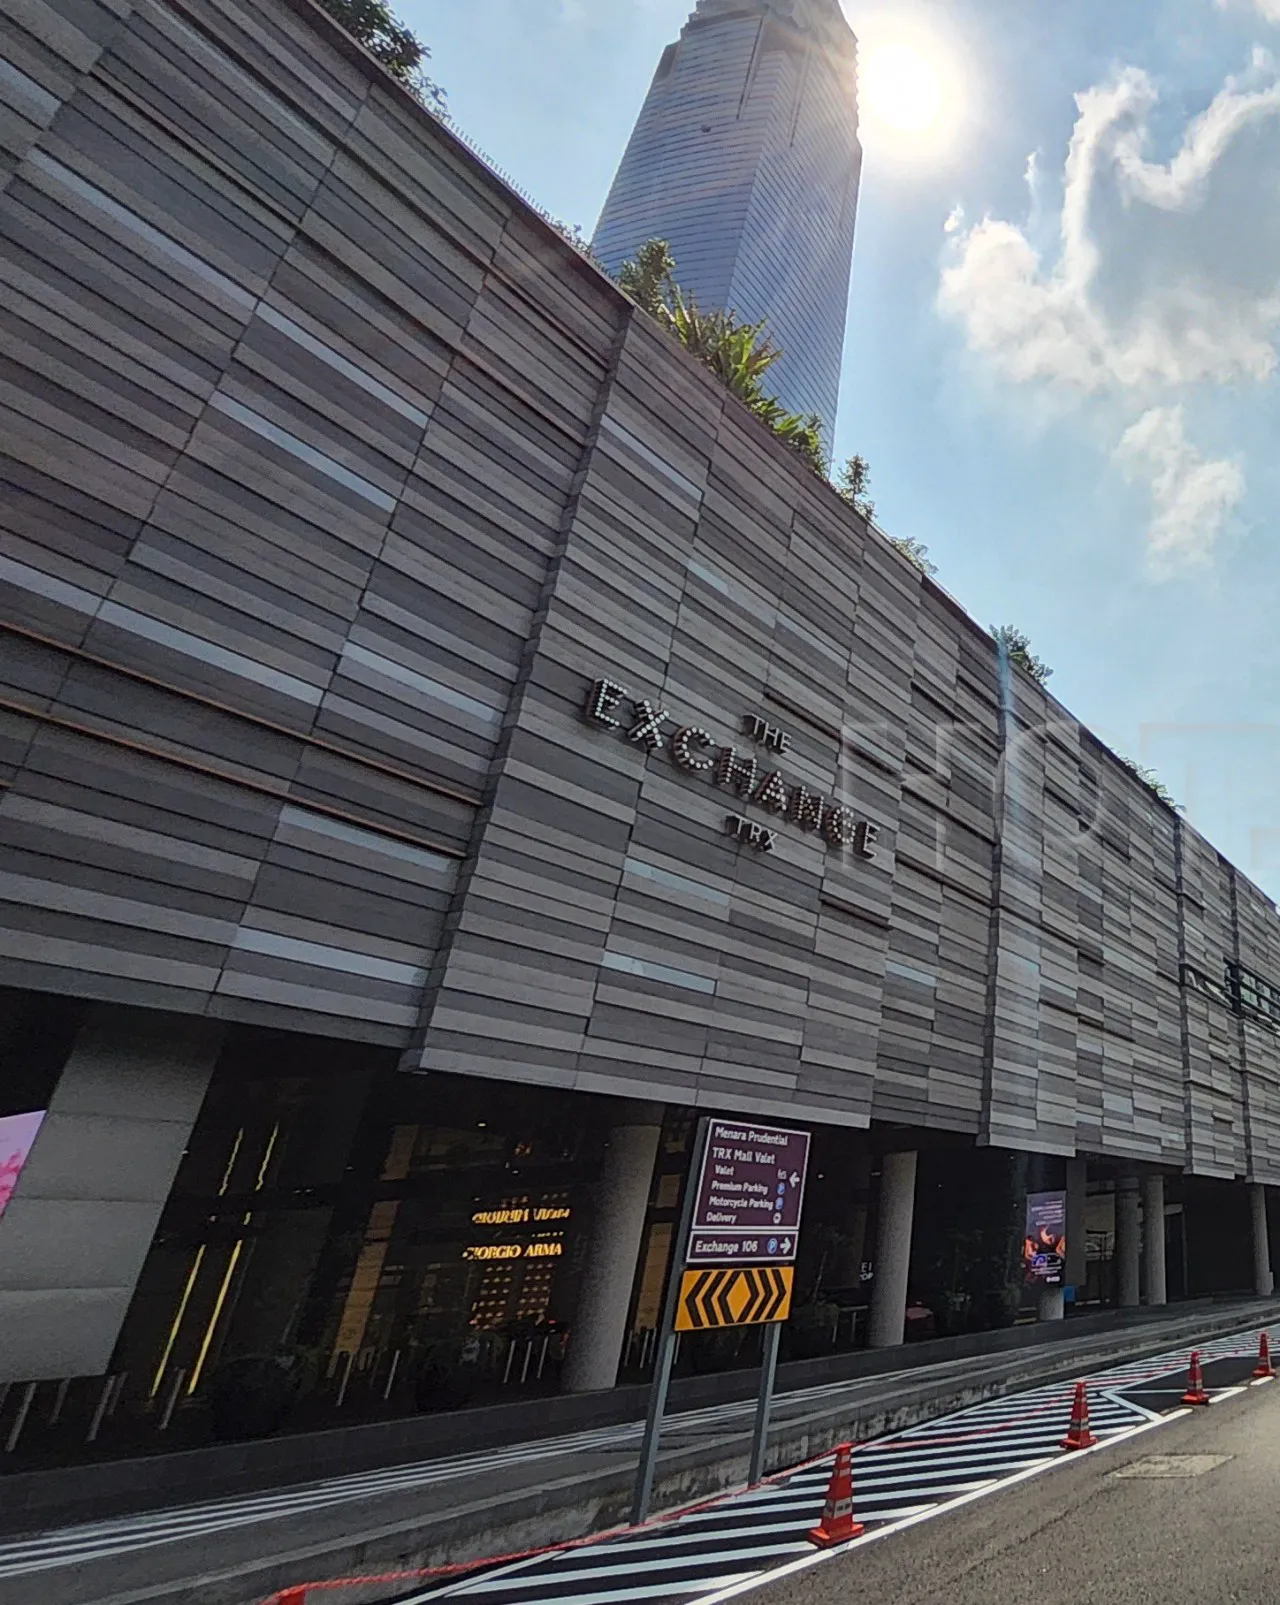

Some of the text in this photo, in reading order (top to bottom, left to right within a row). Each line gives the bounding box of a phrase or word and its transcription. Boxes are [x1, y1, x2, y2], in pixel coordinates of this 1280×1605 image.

[745, 714, 793, 753] THE
[586, 677, 882, 860] EXCHANGE
[727, 814, 779, 852] TRX
[714, 1126, 789, 1146] Menara Prudential
[712, 1146, 775, 1165] TRX Mall Valet
[715, 1164, 734, 1176] Valet
[711, 1180, 769, 1195] Premium Parking
[708, 1196, 774, 1211] Motorcycle Parking
[706, 1211, 737, 1224] Delivery
[695, 1240, 739, 1254] Exchange
[742, 1240, 759, 1253] 106
